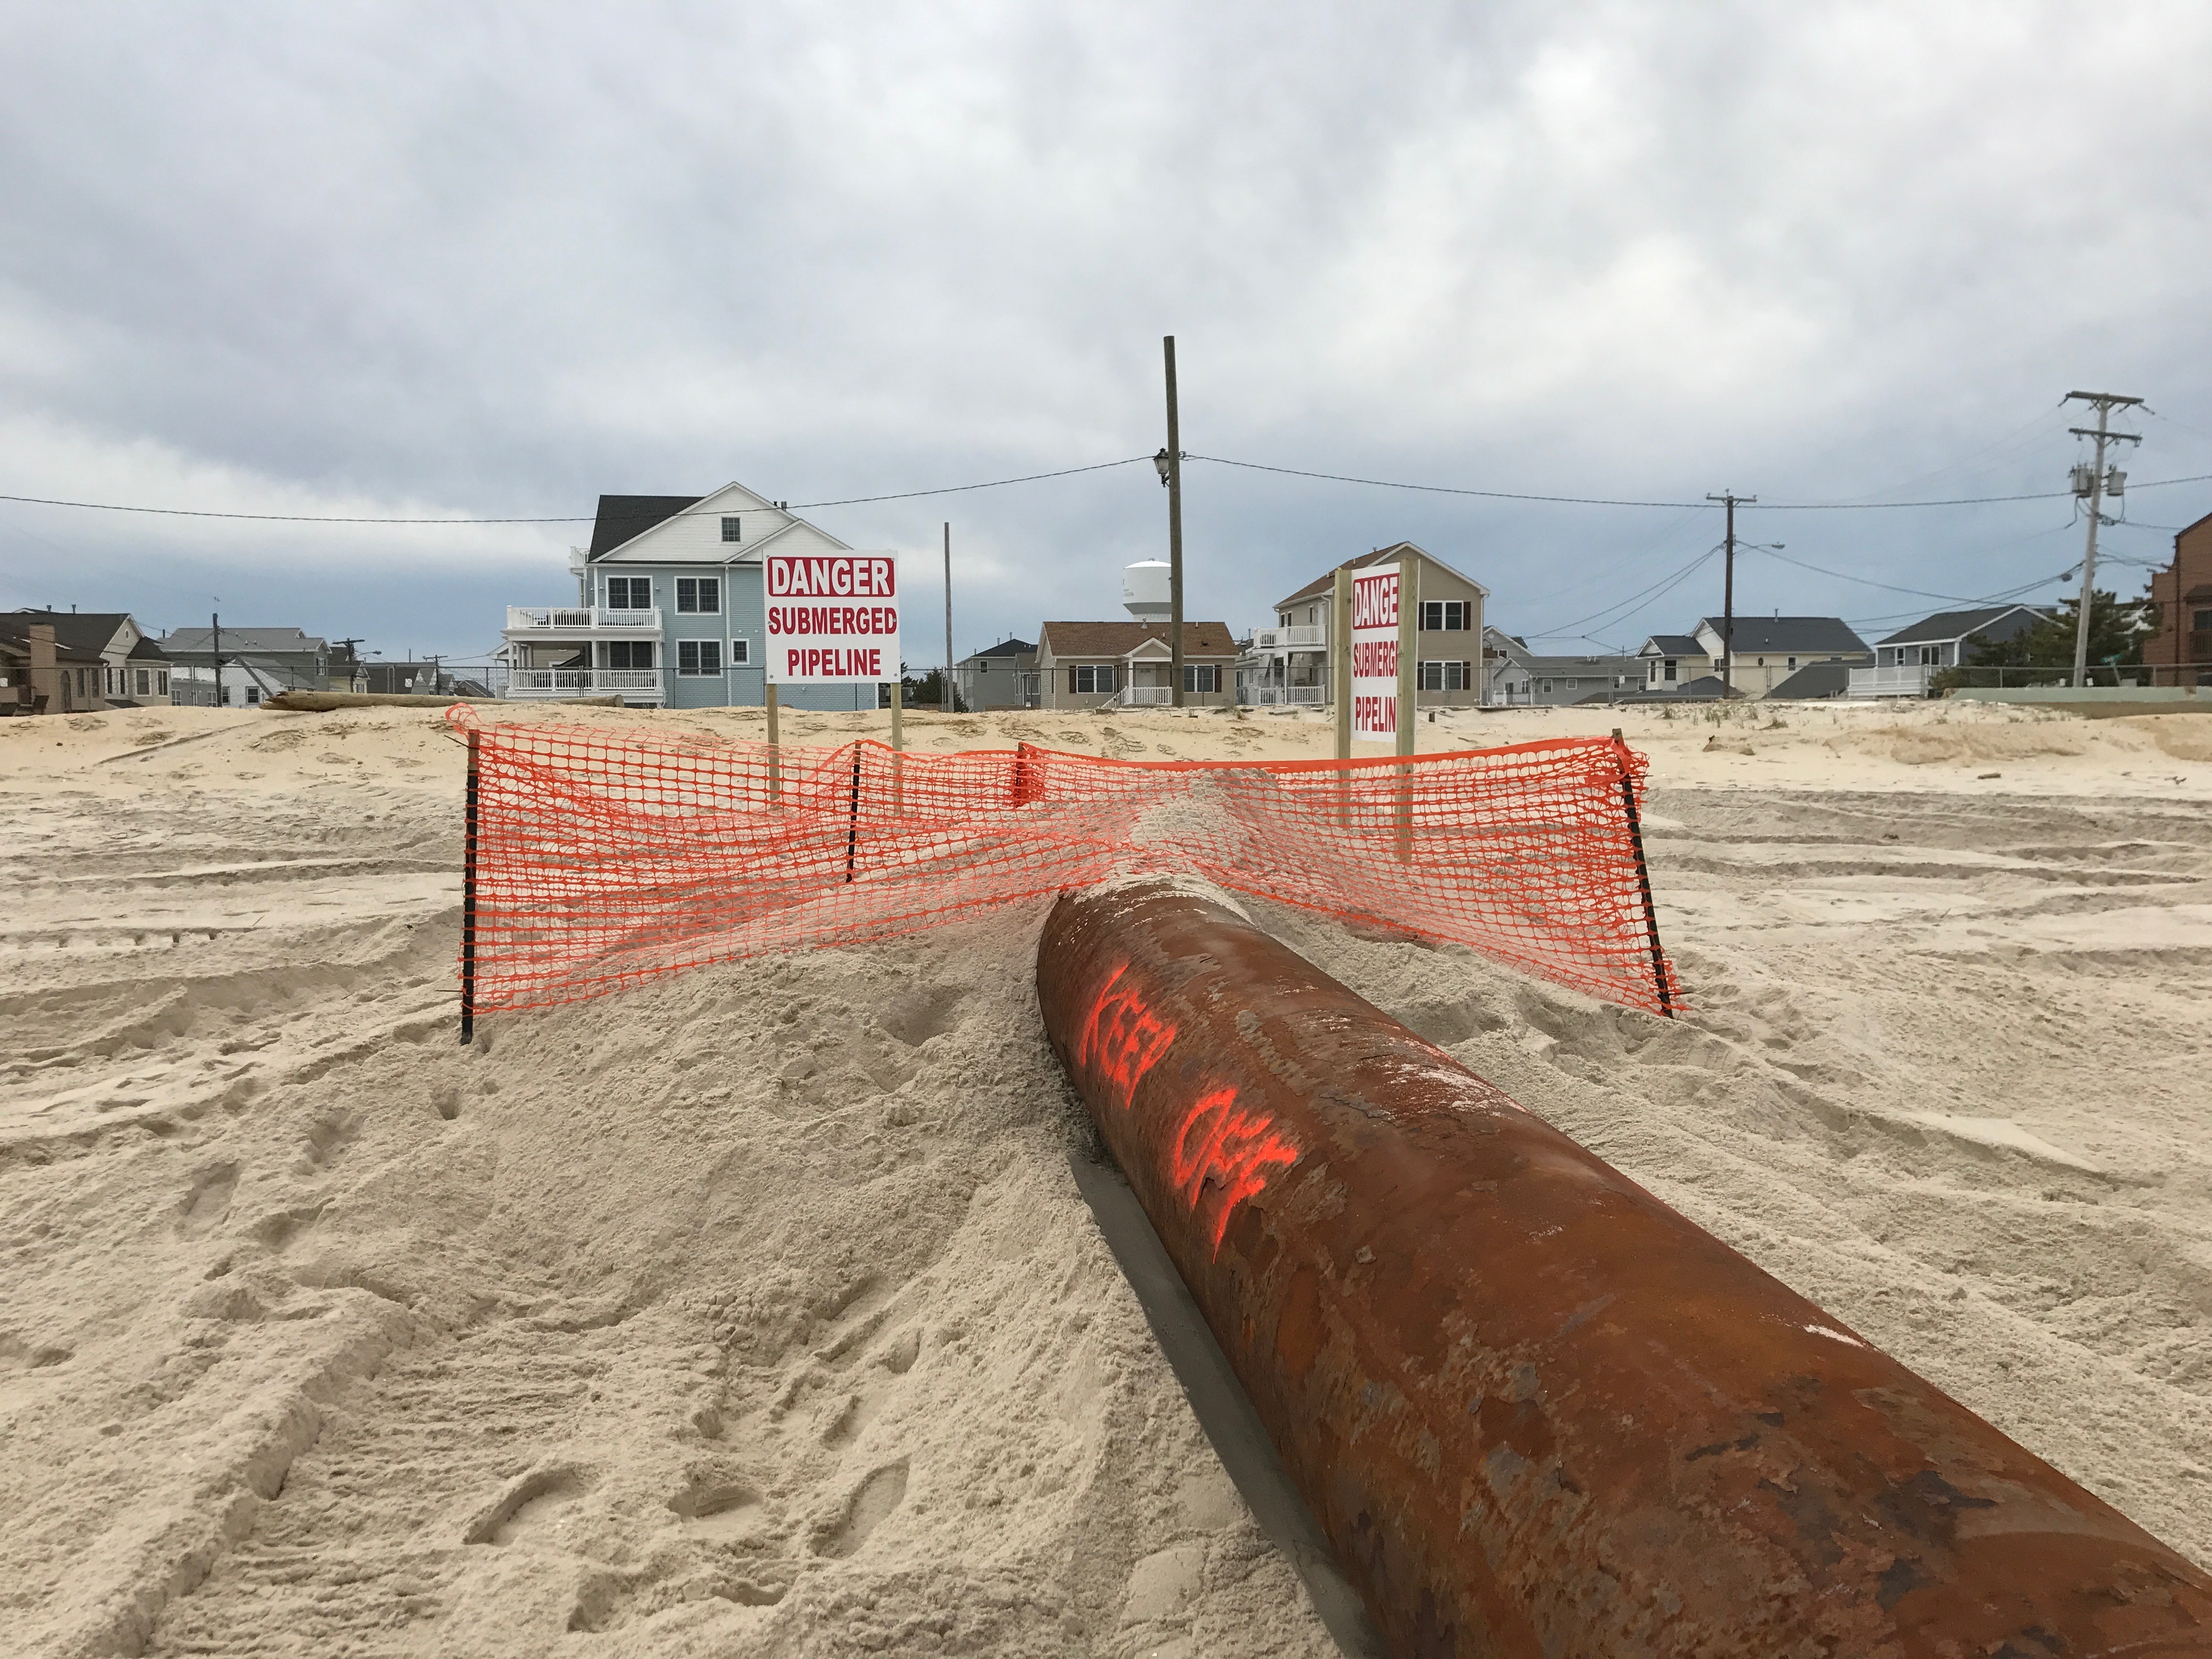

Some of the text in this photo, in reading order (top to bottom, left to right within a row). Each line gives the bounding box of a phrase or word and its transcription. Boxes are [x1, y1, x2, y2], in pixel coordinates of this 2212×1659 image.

[771, 558, 890, 595] DANGER
[768, 606, 898, 635] SUBMERGED
[787, 648, 881, 676] PIPELINE
[1077, 962, 1177, 1110] KEEP
